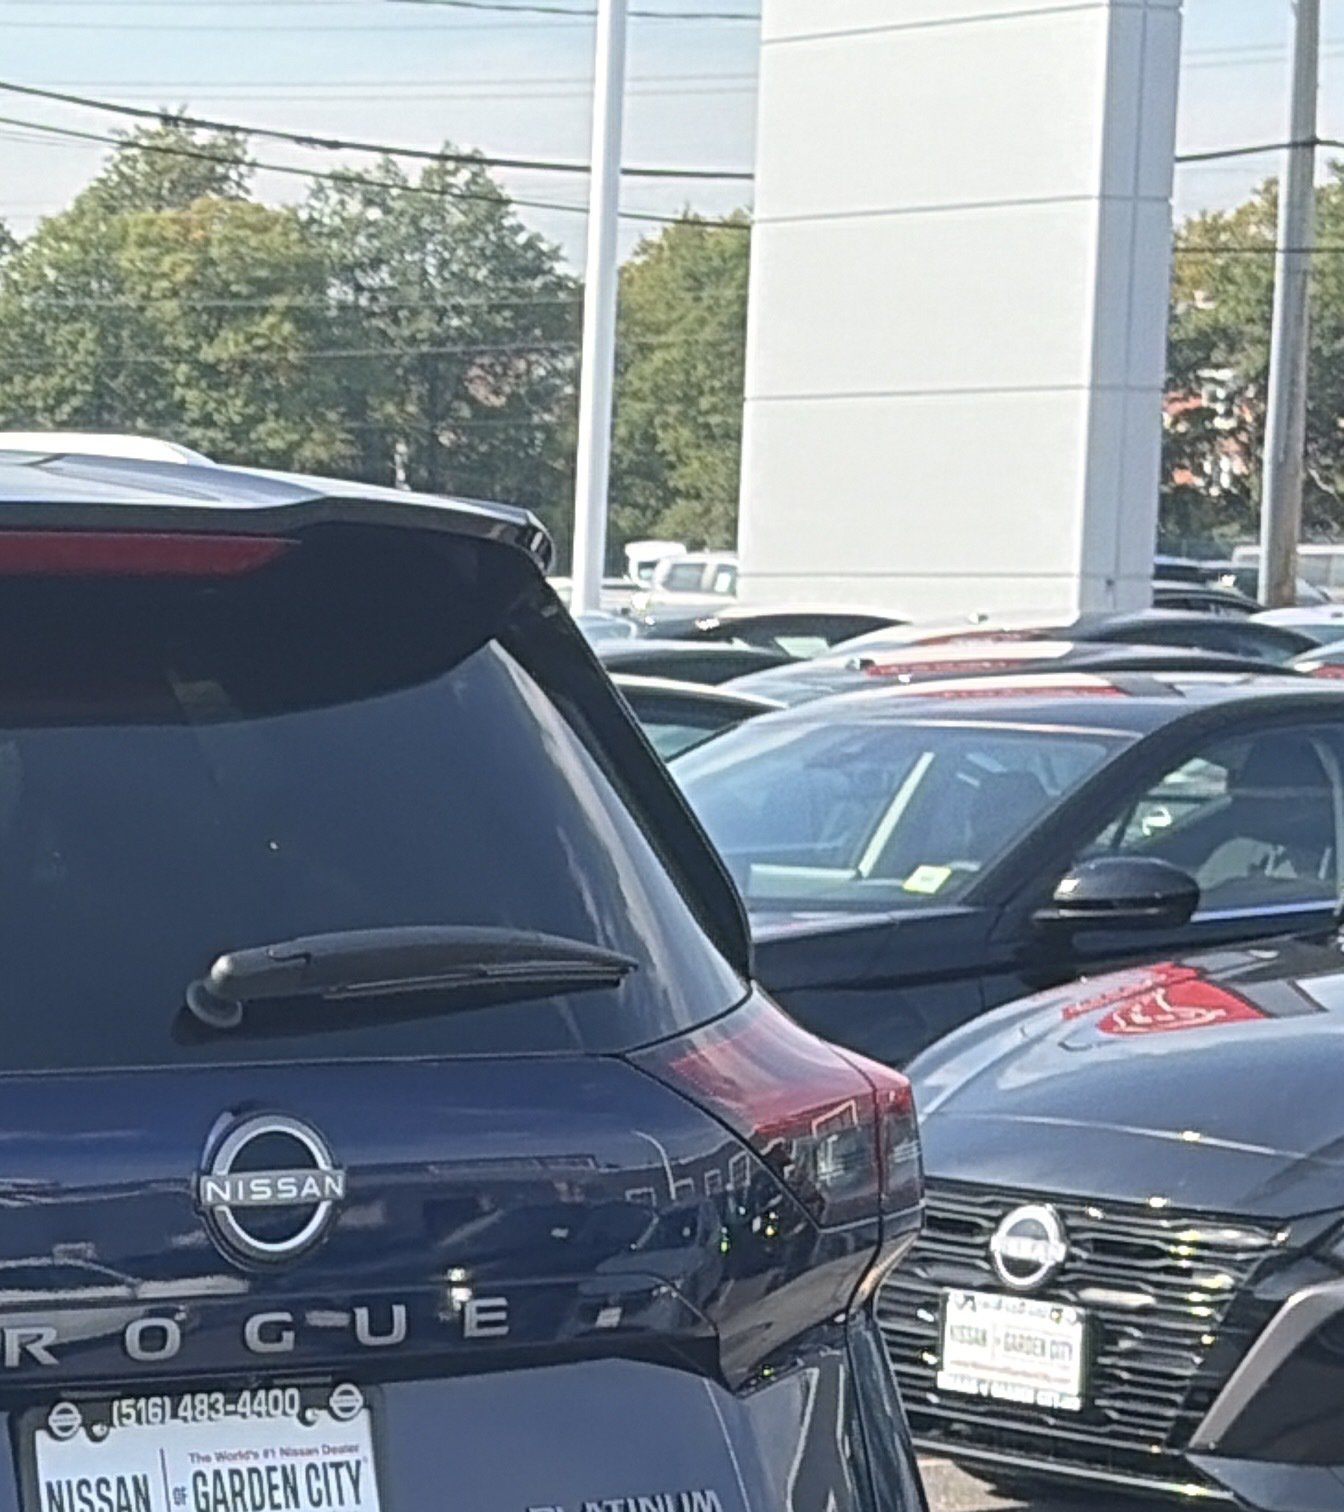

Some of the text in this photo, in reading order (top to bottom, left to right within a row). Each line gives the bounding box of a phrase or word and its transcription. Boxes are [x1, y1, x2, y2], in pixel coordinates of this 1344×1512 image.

[205, 1173, 344, 1203] NISSAN
[3, 1297, 509, 1368] ROGUE
[112, 1387, 301, 1426] (516) 483-4400
[305, 1460, 362, 1508] CITY
